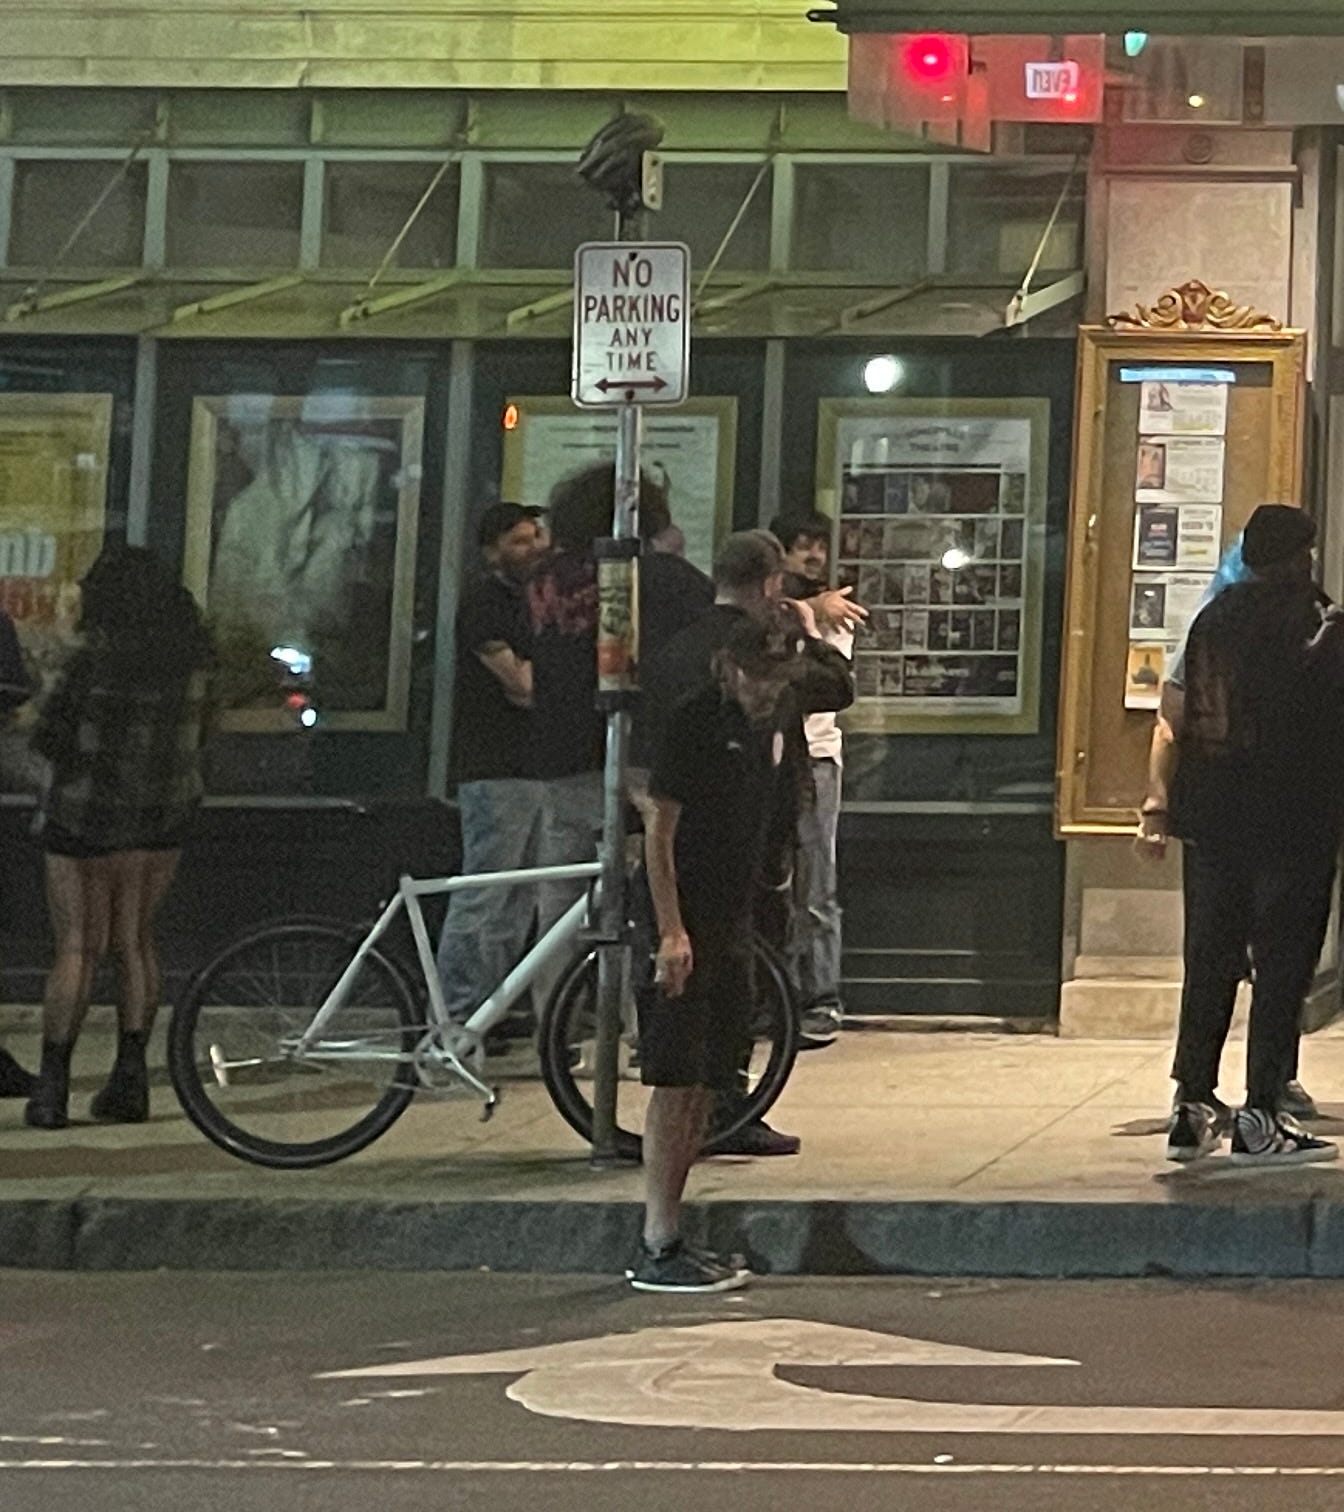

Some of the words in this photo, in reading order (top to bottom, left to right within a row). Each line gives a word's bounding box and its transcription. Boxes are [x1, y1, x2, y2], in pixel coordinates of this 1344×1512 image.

[612, 259, 653, 288] NO
[584, 294, 680, 323] PARKING
[610, 327, 653, 348] ANY
[606, 350, 658, 372] TIME
